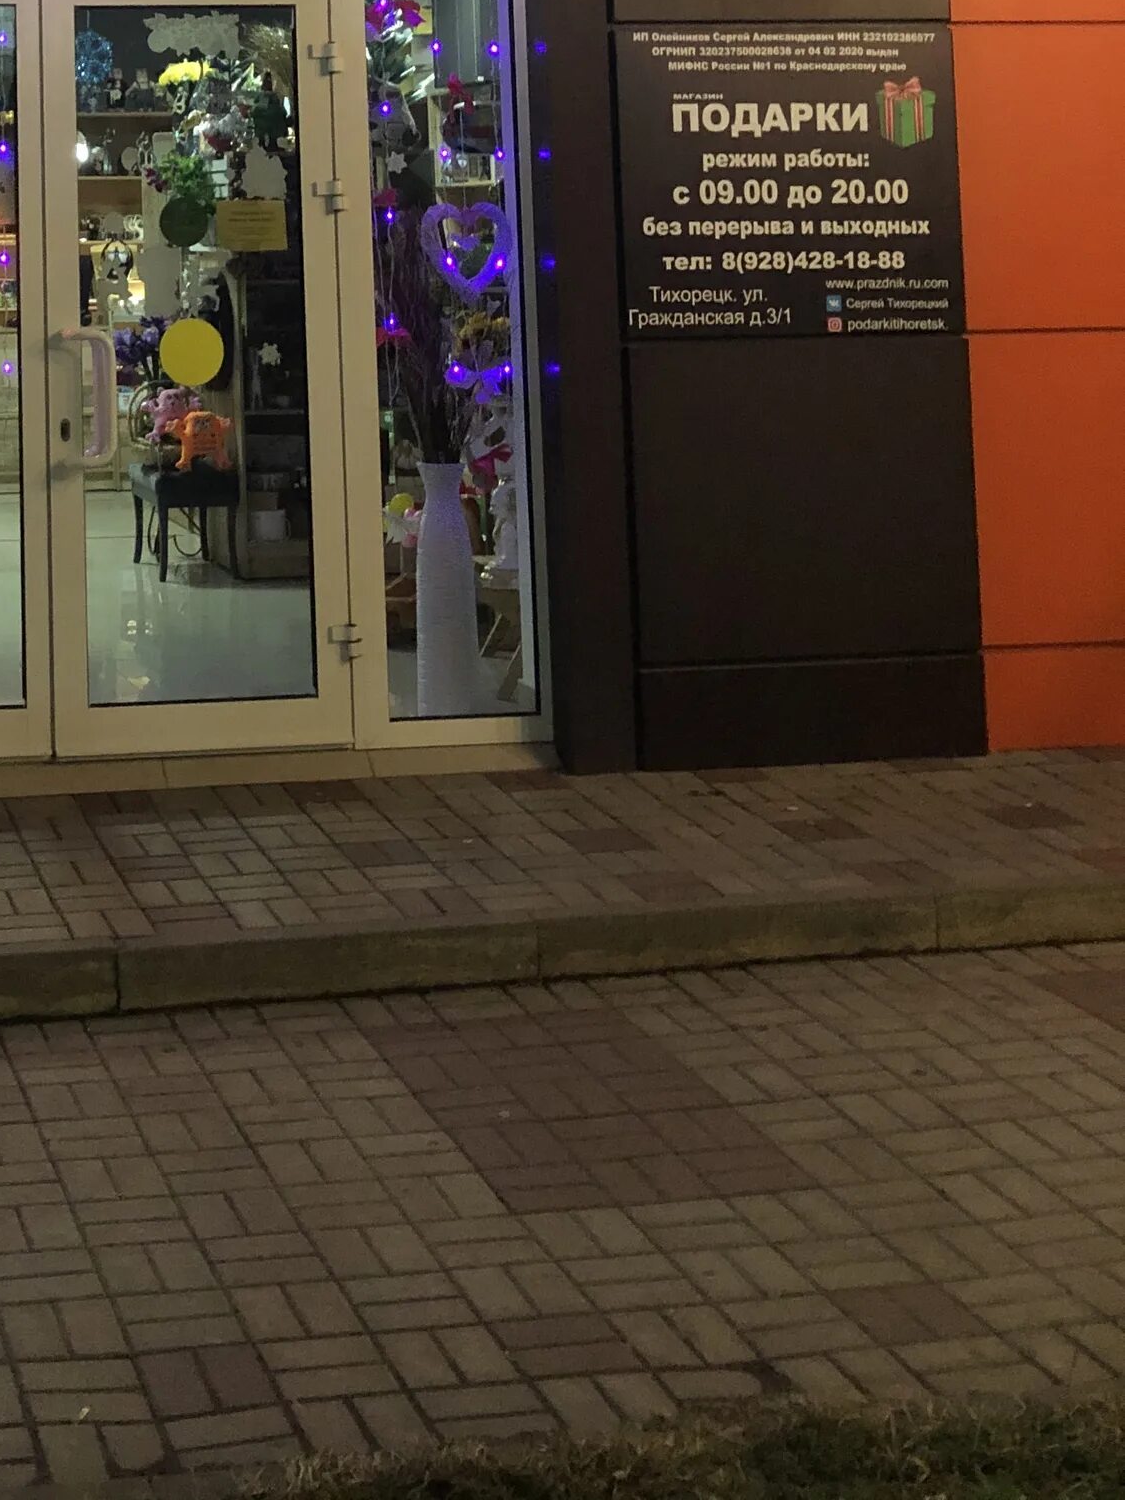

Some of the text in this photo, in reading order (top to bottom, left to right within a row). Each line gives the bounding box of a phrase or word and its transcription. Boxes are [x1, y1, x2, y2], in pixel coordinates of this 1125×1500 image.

[633, 32, 649, 42] ИП
[713, 32, 750, 43] Сергей
[752, 32, 834, 43] Александрович
[837, 33, 860, 42] ИНН
[652, 46, 696, 56] ОГРНИП
[866, 49, 899, 57] выдан
[668, 61, 907, 73] МИФНС России №1 по Краснодарскому краю
[672, 102, 869, 138] ПОДАРКИ
[702, 150, 870, 173] режим работы:
[673, 179, 909, 208] с 09.00 до 20.00
[642, 216, 930, 239] без перерыва и выходных
[662, 250, 906, 274] тел: 8(928)428-18-88
[743, 288, 768, 305] ул.
[846, 298, 949, 310] Сергей Тихорецкий
[628, 307, 792, 329] Гражданская д.3/1
